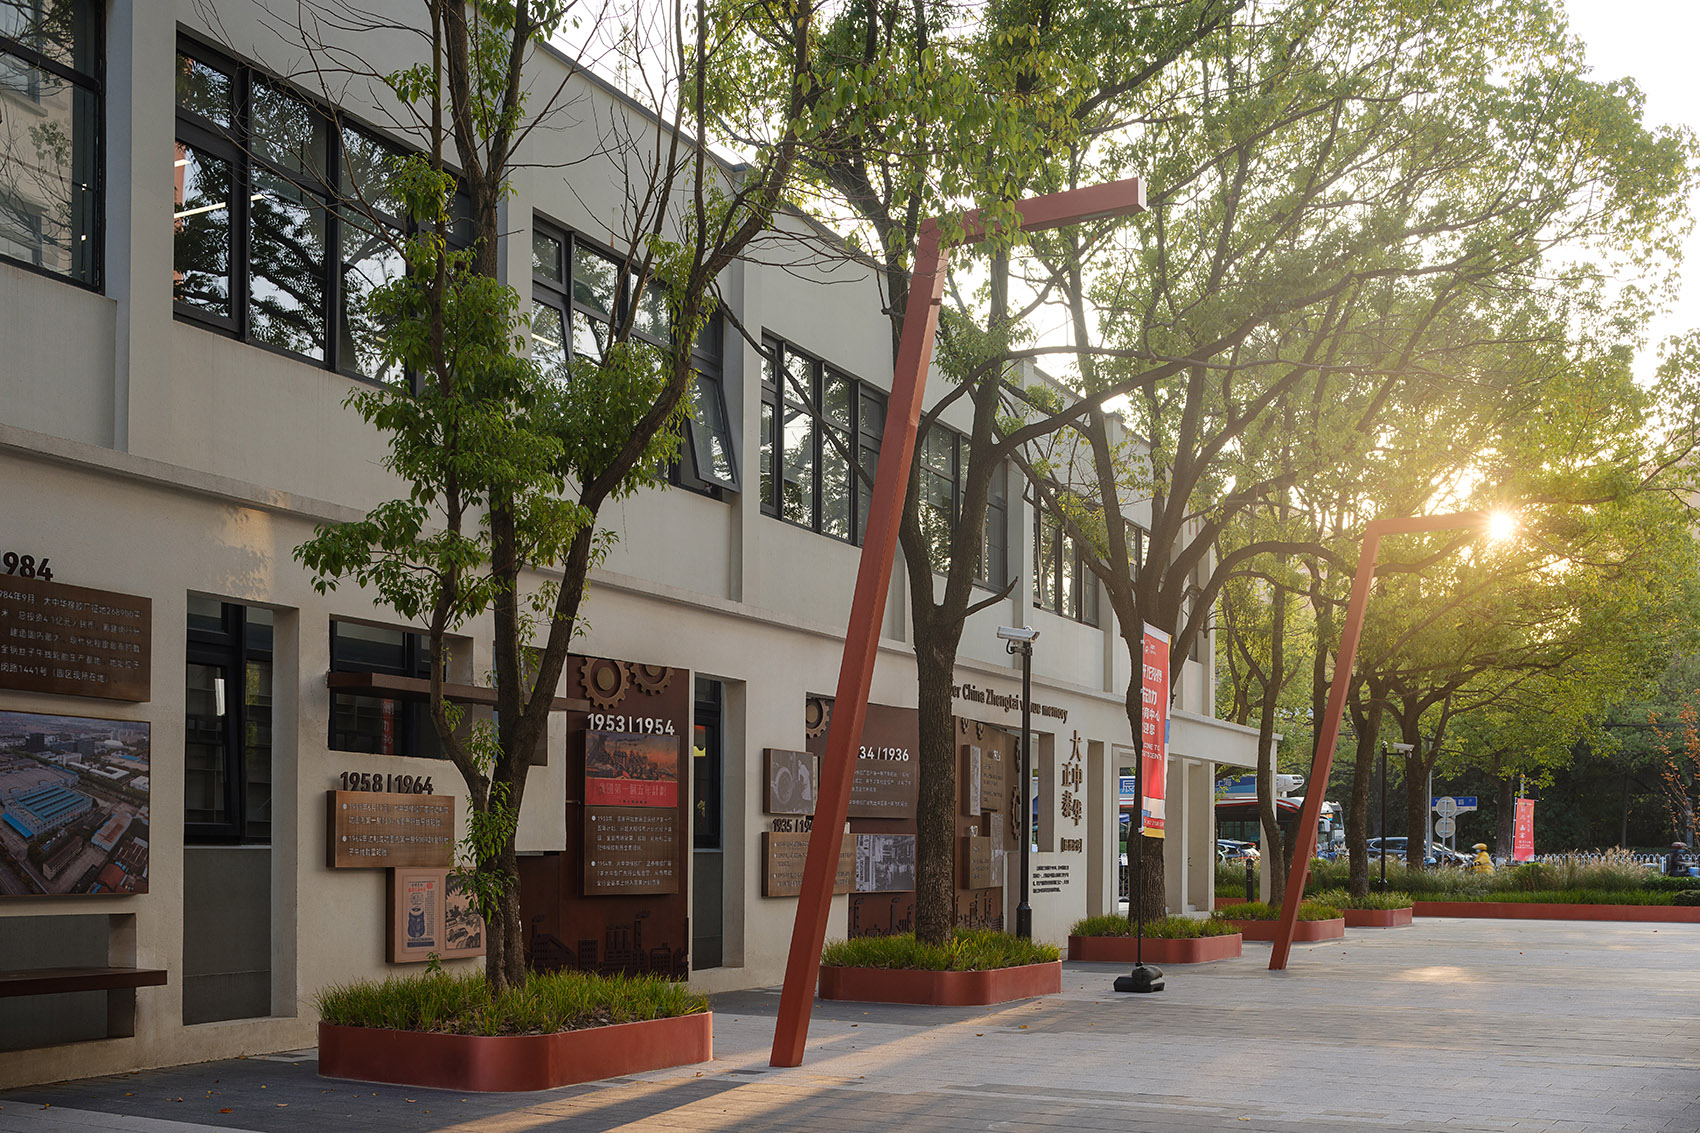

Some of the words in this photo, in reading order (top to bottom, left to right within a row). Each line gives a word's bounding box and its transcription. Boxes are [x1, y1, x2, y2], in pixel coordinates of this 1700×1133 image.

[0, 551, 53, 581] 984
[962, 683, 985, 704] China
[986, 688, 1019, 713] Zhengtai
[1042, 705, 1068, 724] memory
